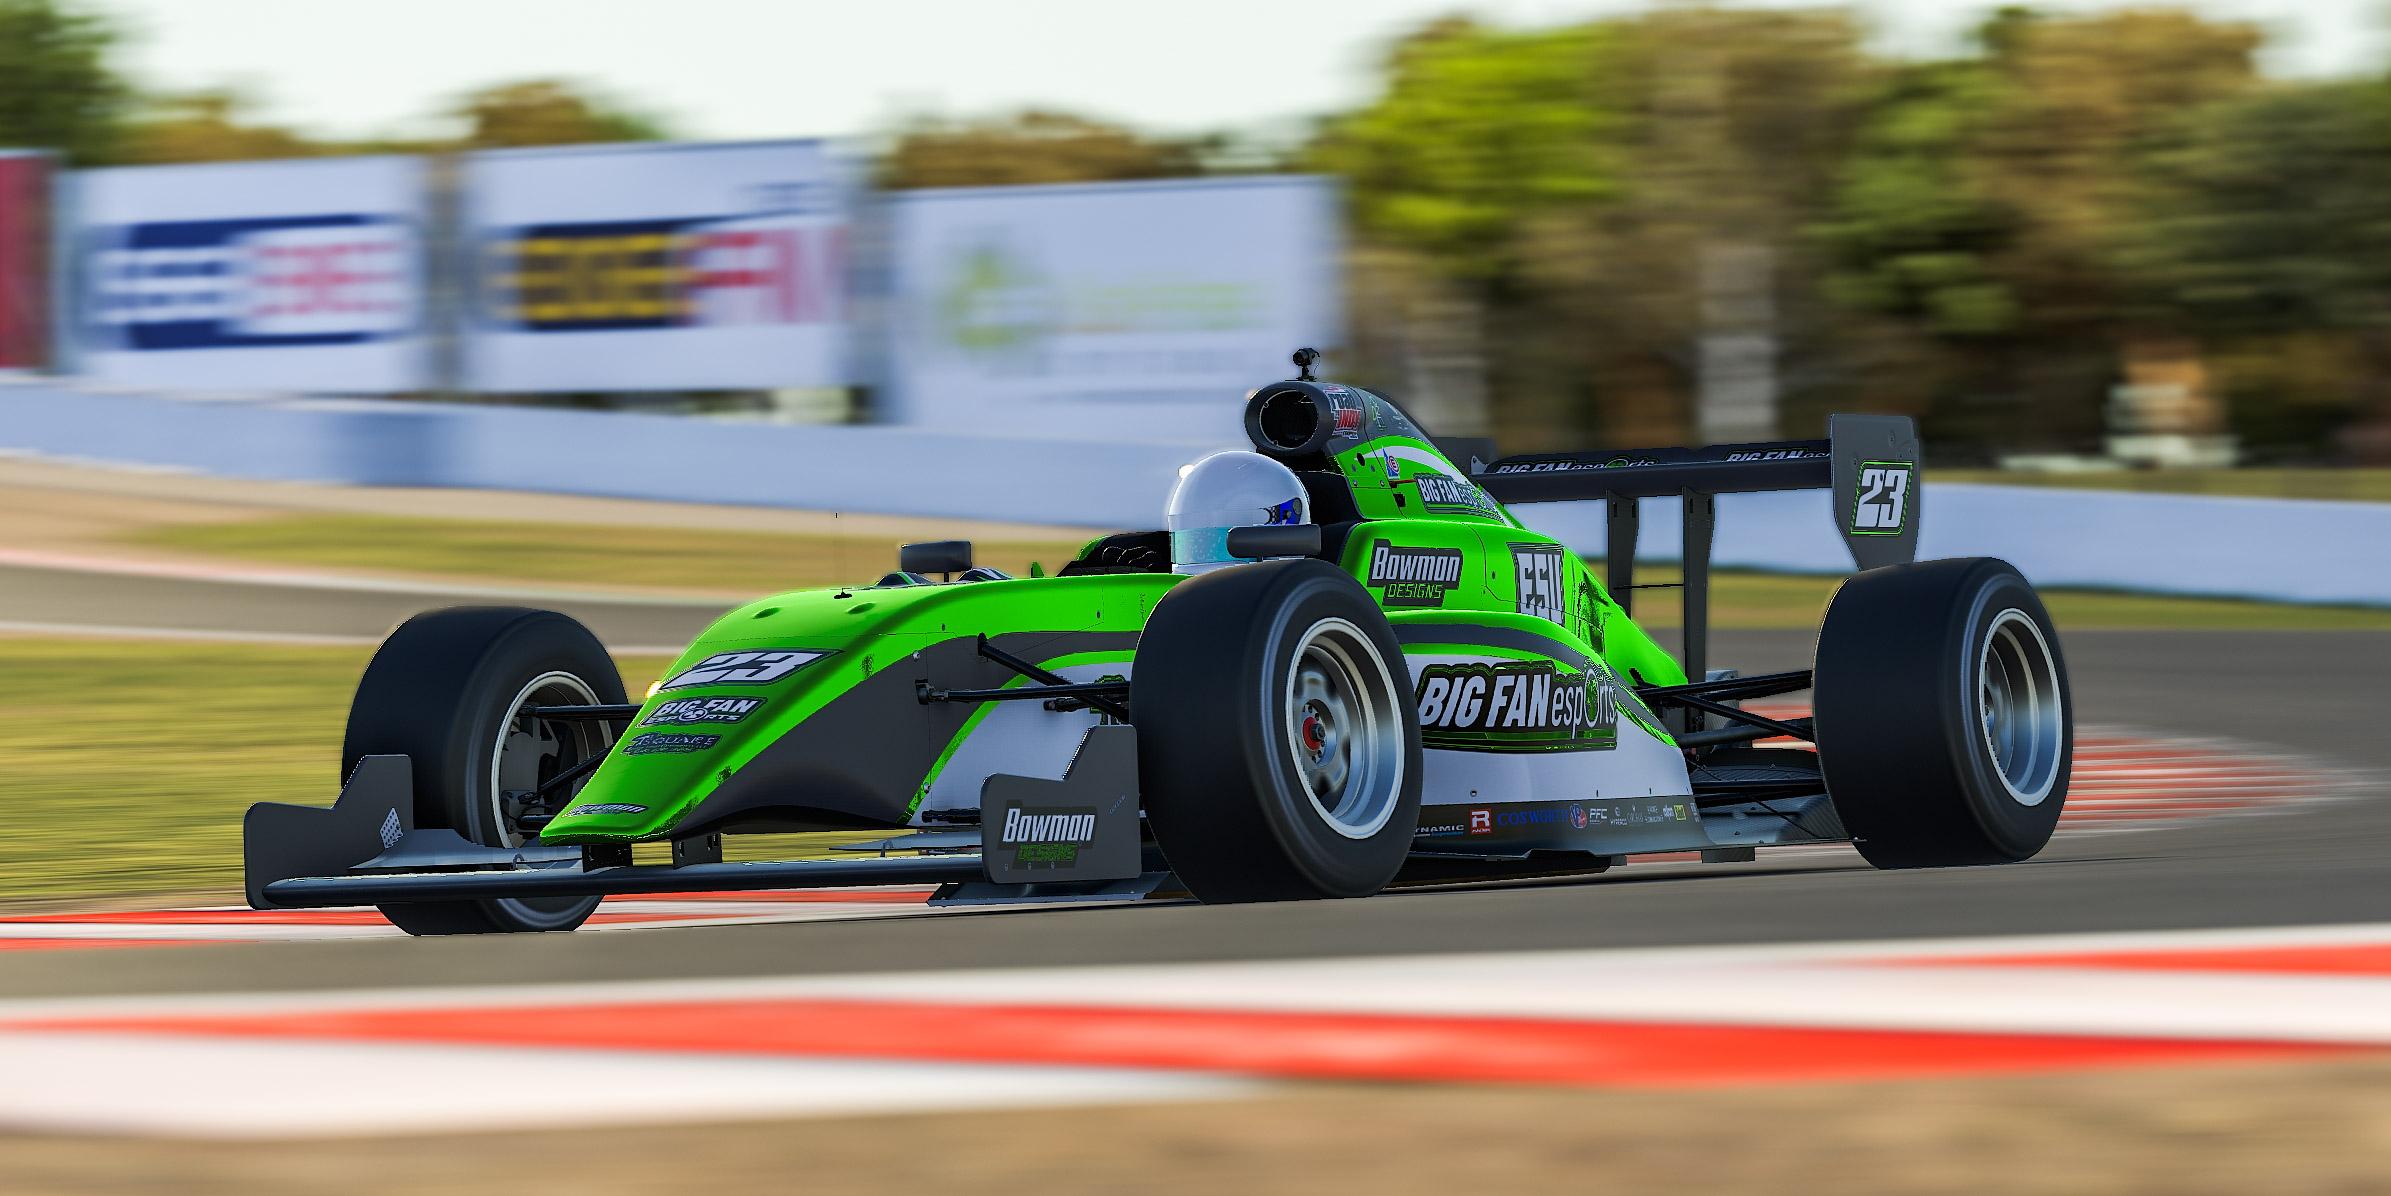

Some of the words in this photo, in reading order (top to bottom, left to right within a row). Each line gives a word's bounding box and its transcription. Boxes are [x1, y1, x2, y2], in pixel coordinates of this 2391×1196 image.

[1418, 479, 1440, 502] BIG
[1437, 480, 1462, 503] FAN
[1855, 469, 1908, 527] 23
[1371, 546, 1461, 582] Bowman
[1388, 583, 1442, 599] DESIGNS
[659, 651, 824, 689] 23
[655, 699, 702, 717] BIG
[703, 698, 758, 713] FAN
[1419, 674, 1487, 728] BIG
[1485, 673, 1551, 728] FAN
[1002, 808, 1096, 842] Bowman
[1590, 808, 1608, 819] PFC
